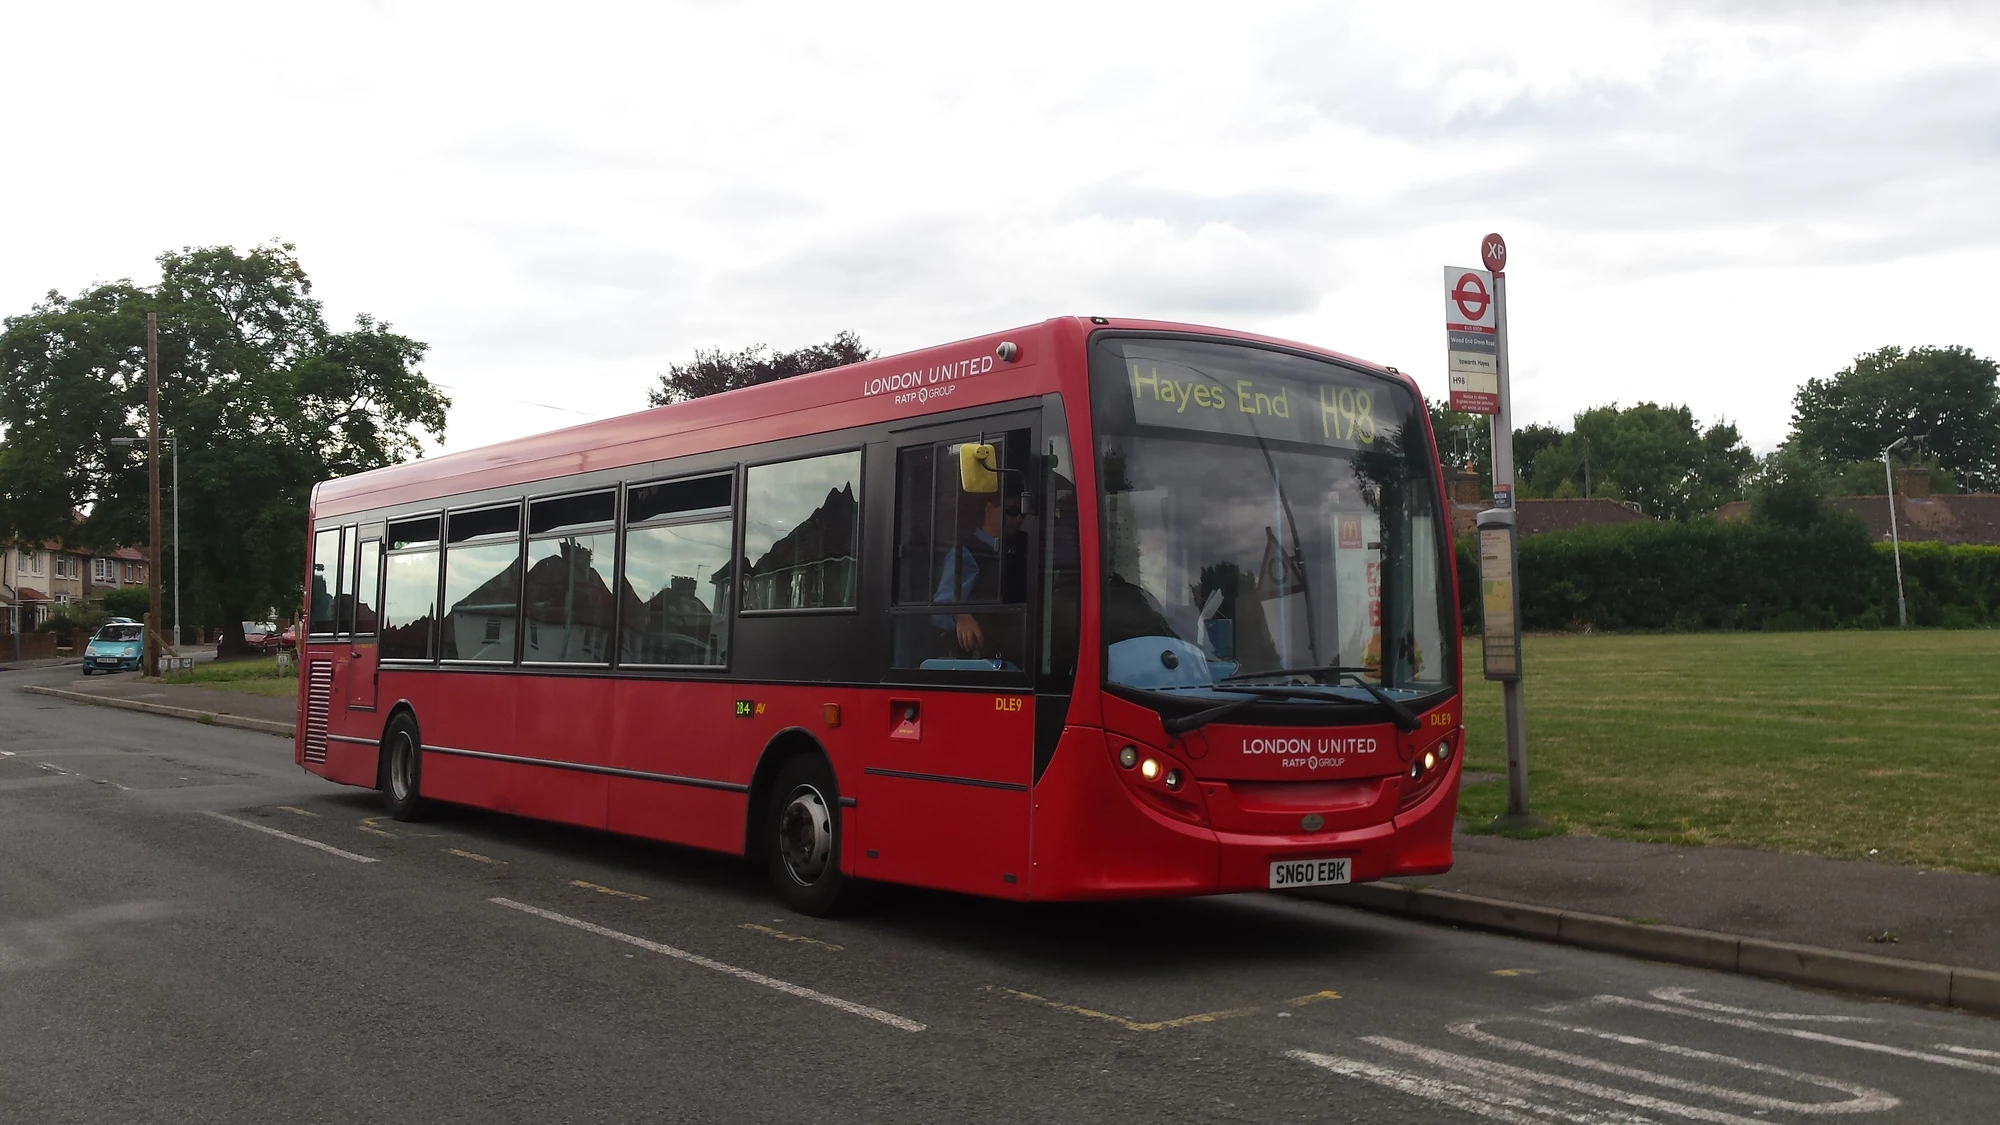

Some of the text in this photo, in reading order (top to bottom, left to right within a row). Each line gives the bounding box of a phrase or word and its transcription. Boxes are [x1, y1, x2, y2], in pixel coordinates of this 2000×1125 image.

[1487, 241, 1504, 260] XP
[1451, 336, 1464, 344] Wood
[1473, 338, 1485, 346] Green
[1458, 358, 1490, 368] towards Hayes
[864, 355, 993, 396] LONDON UNITED
[1453, 376, 1466, 385] H98
[895, 385, 955, 404] RATP GROUP
[1133, 364, 1289, 418] Hayes End
[1320, 386, 1376, 444] H98
[995, 698, 1022, 712] DLE9
[1431, 713, 1451, 726] DLE9
[1243, 738, 1377, 754] LONDON UNITED
[1282, 758, 1345, 768] RATP GROUP
[1276, 861, 1345, 884] SN60 EBK
